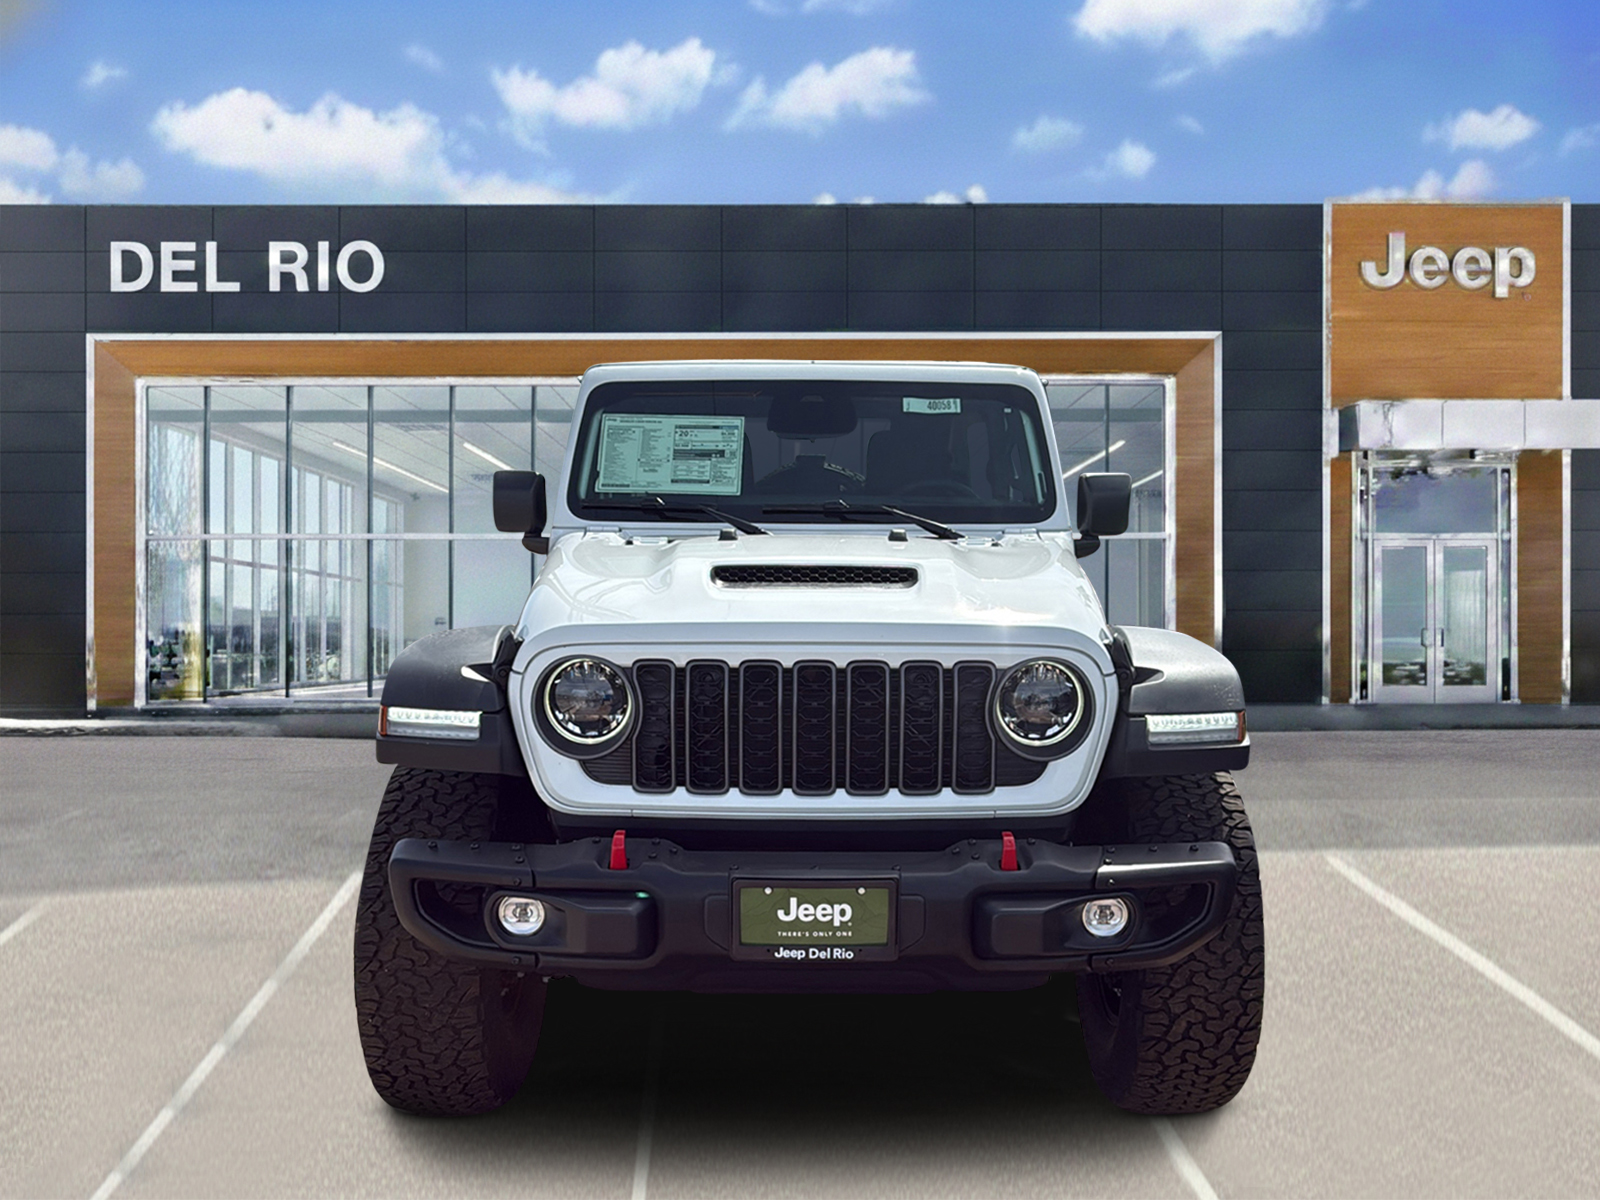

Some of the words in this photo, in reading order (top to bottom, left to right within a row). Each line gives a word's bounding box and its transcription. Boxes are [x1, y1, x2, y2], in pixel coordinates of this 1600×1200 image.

[110, 241, 240, 292] DEL
[268, 240, 385, 293] RIO
[1360, 231, 1536, 299] Jeep
[777, 897, 852, 926] Jeep
[774, 947, 806, 960] Jeep
[809, 947, 831, 959] Del
[833, 947, 854, 959] Rio
